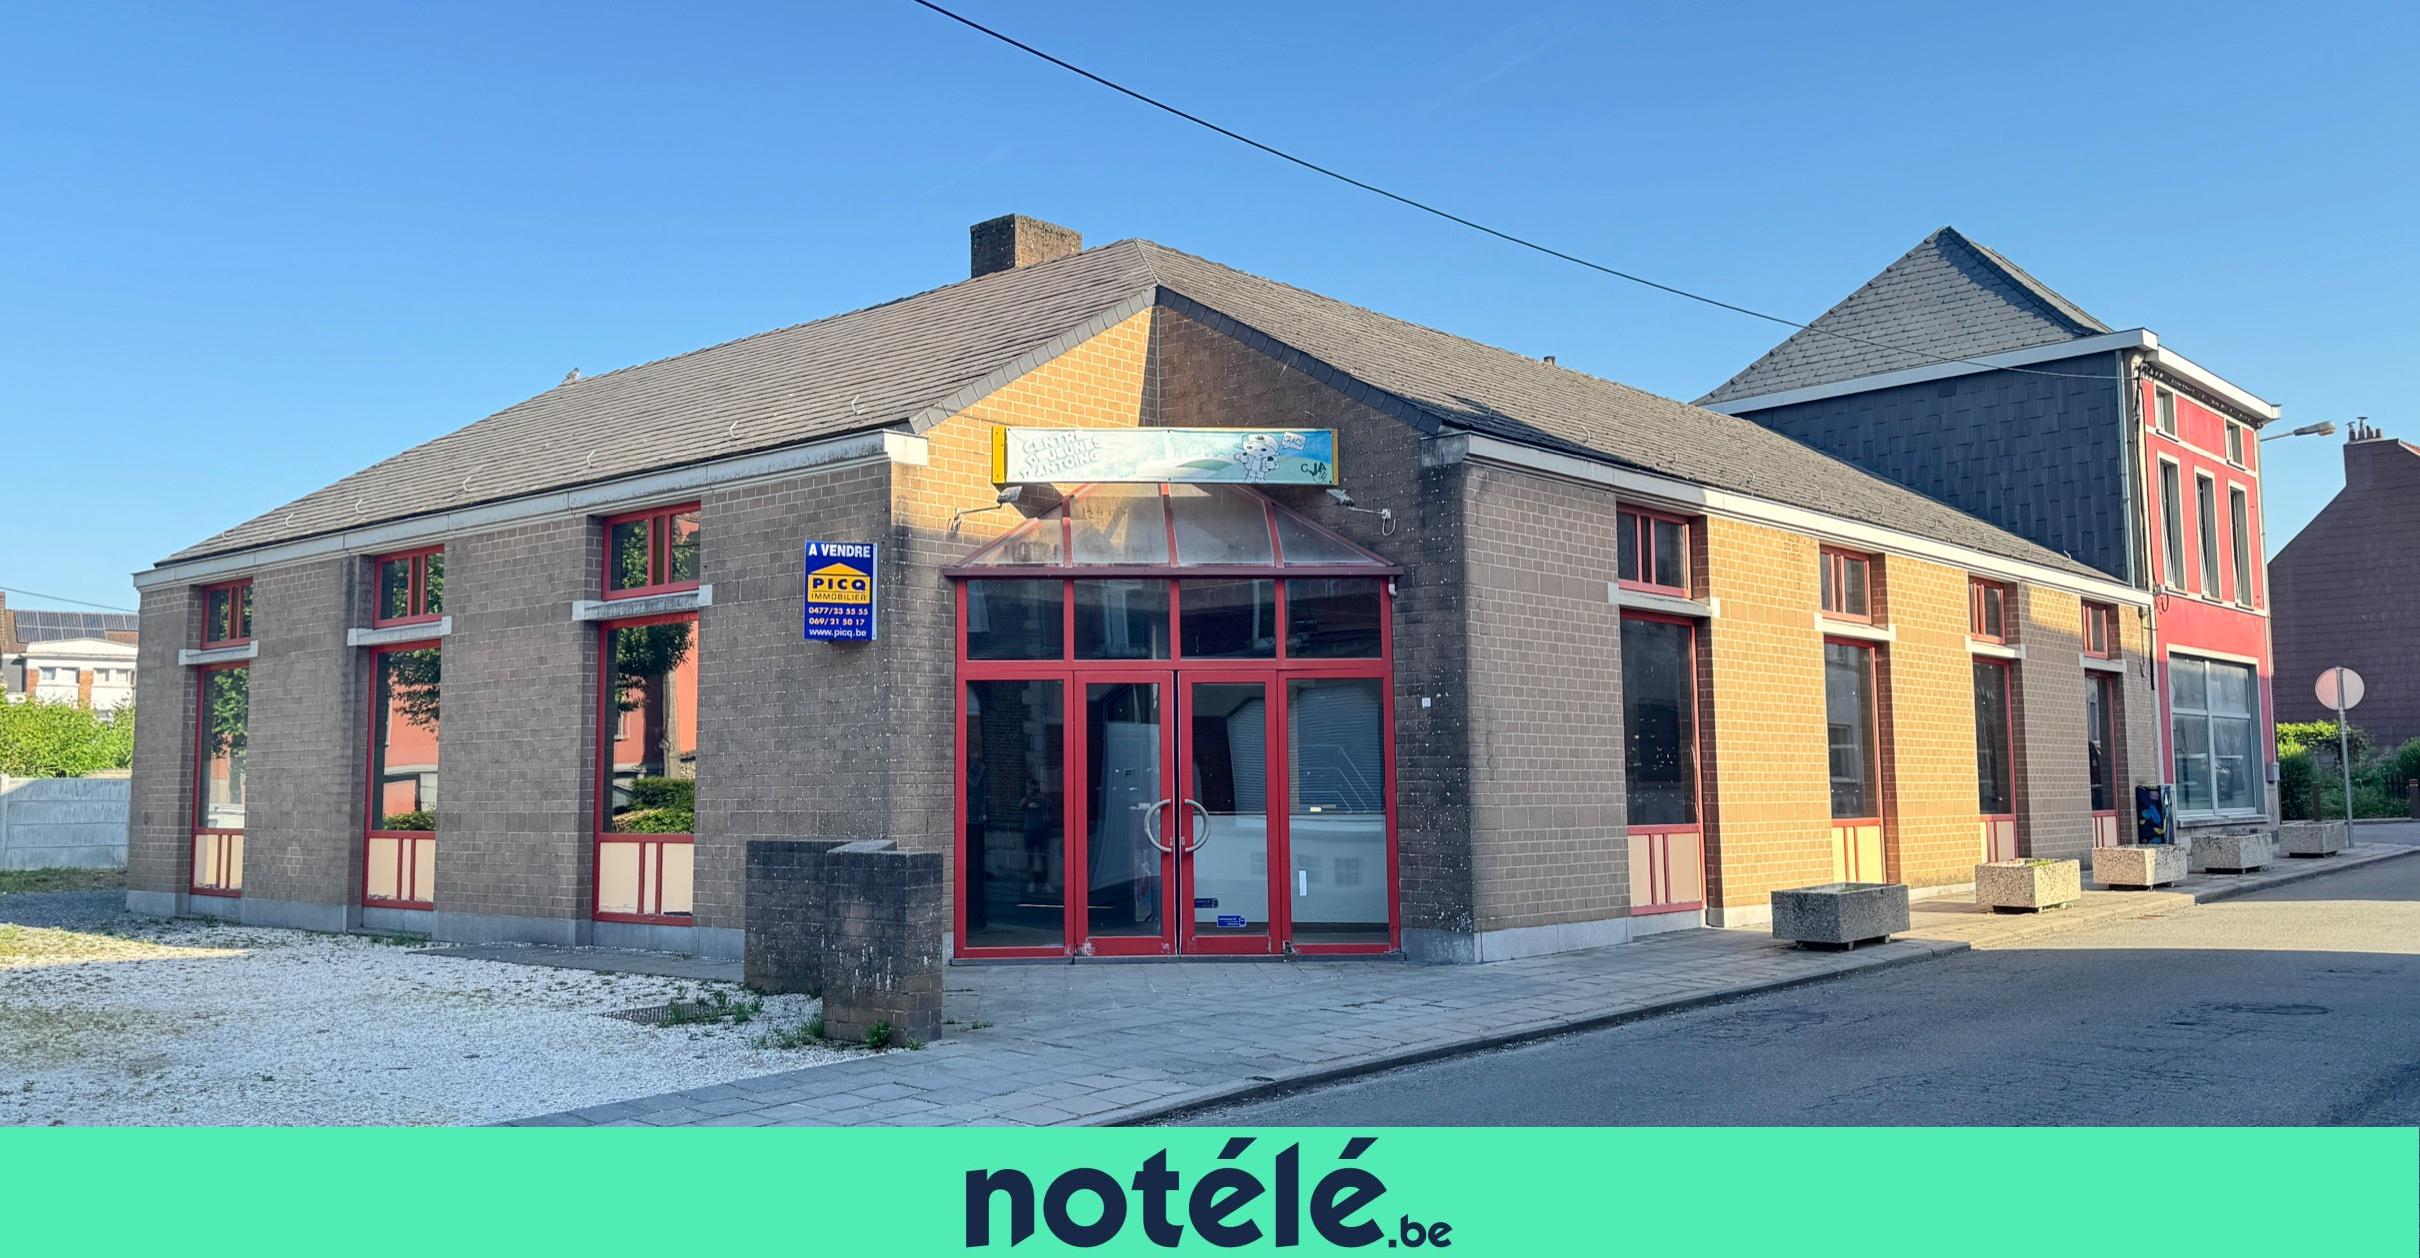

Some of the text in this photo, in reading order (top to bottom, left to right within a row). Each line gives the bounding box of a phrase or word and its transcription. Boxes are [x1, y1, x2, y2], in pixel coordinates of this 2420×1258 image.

[1300, 461, 1326, 476] CJA
[808, 543, 871, 558] A VENDRE
[812, 578, 866, 591] PICQ
[811, 592, 866, 601] IMMOBILIER
[842, 618, 853, 626] 50
[855, 618, 865, 626] 17
[808, 628, 867, 639] www.picq.be
